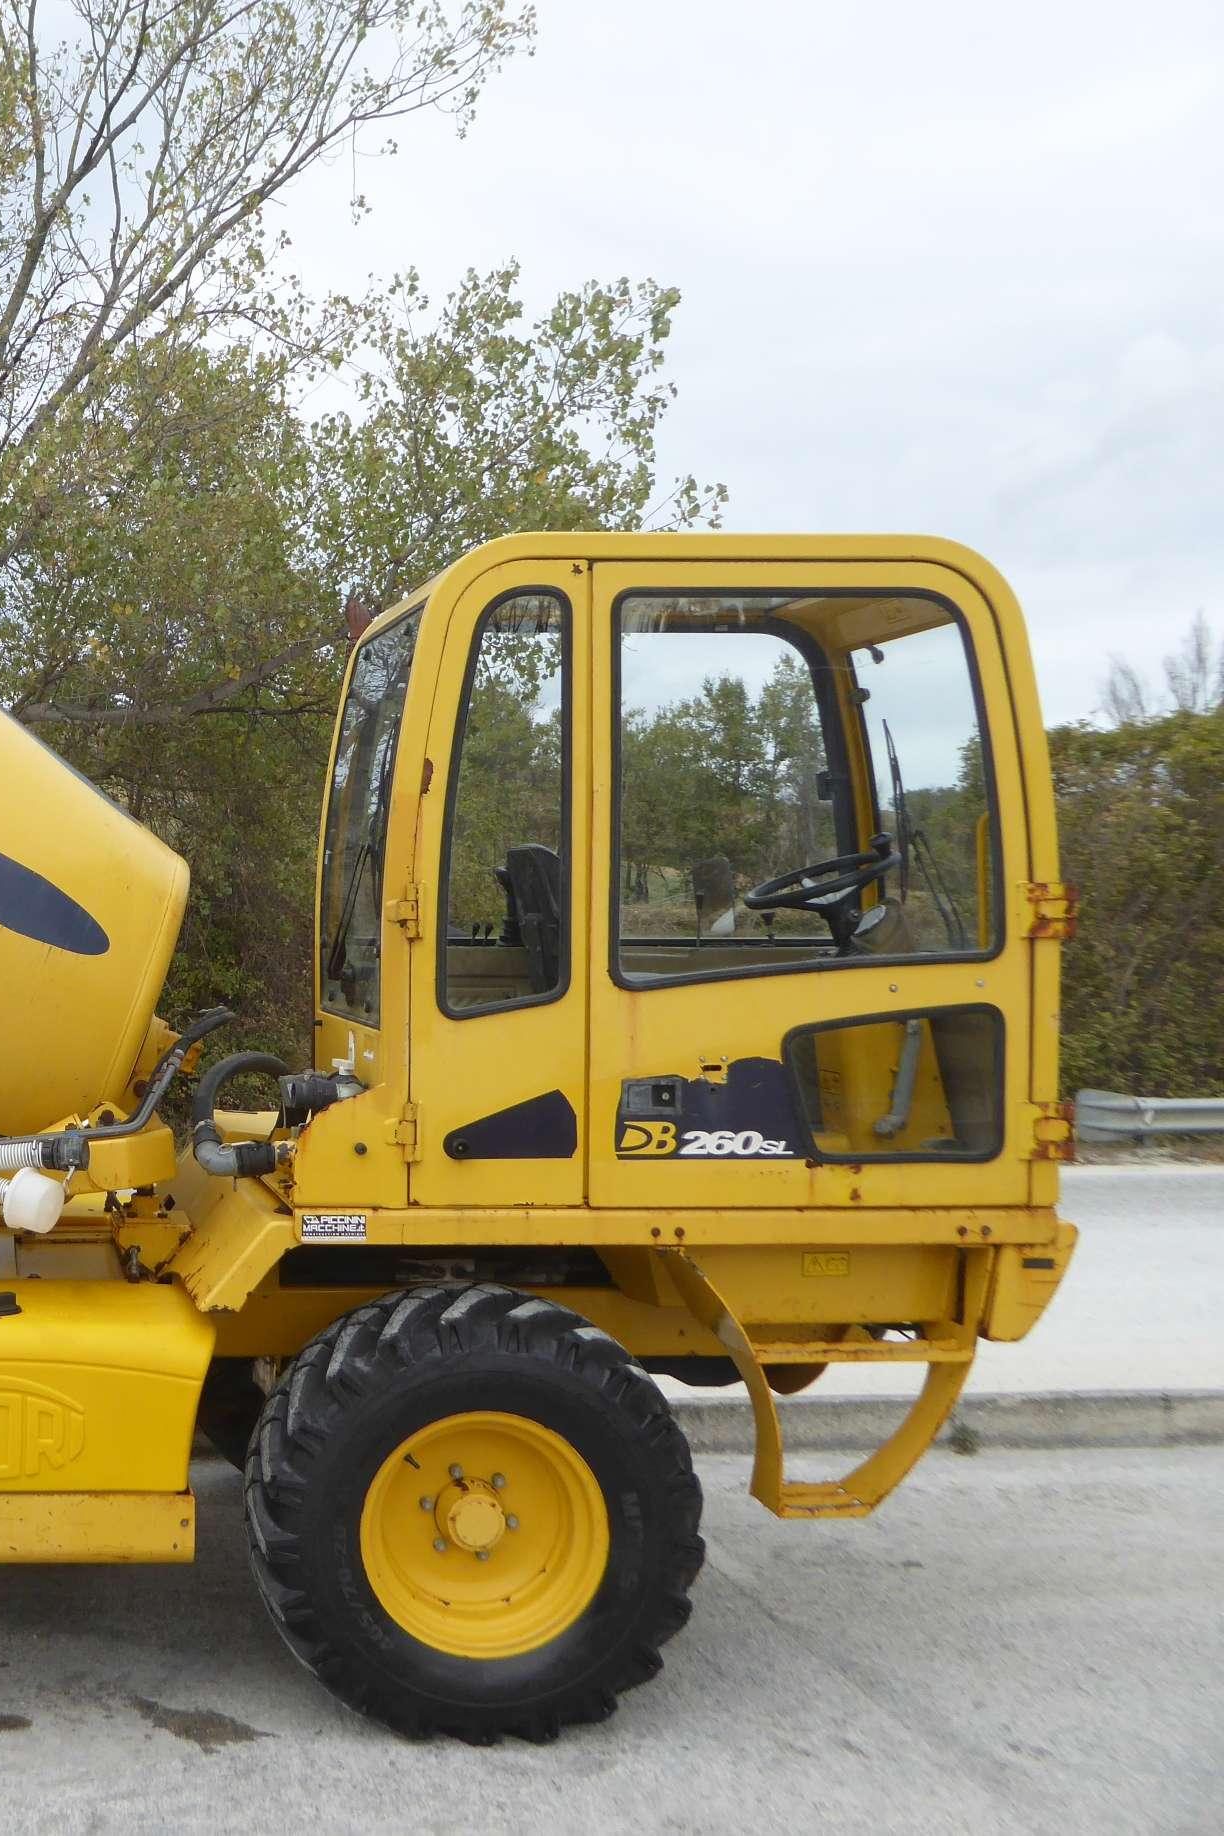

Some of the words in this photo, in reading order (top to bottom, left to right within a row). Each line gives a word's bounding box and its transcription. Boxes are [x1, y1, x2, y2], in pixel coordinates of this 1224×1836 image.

[615, 1121, 677, 1155] DB
[320, 1215, 365, 1224] PICCININI
[302, 1224, 365, 1232] MACCHINE.it
